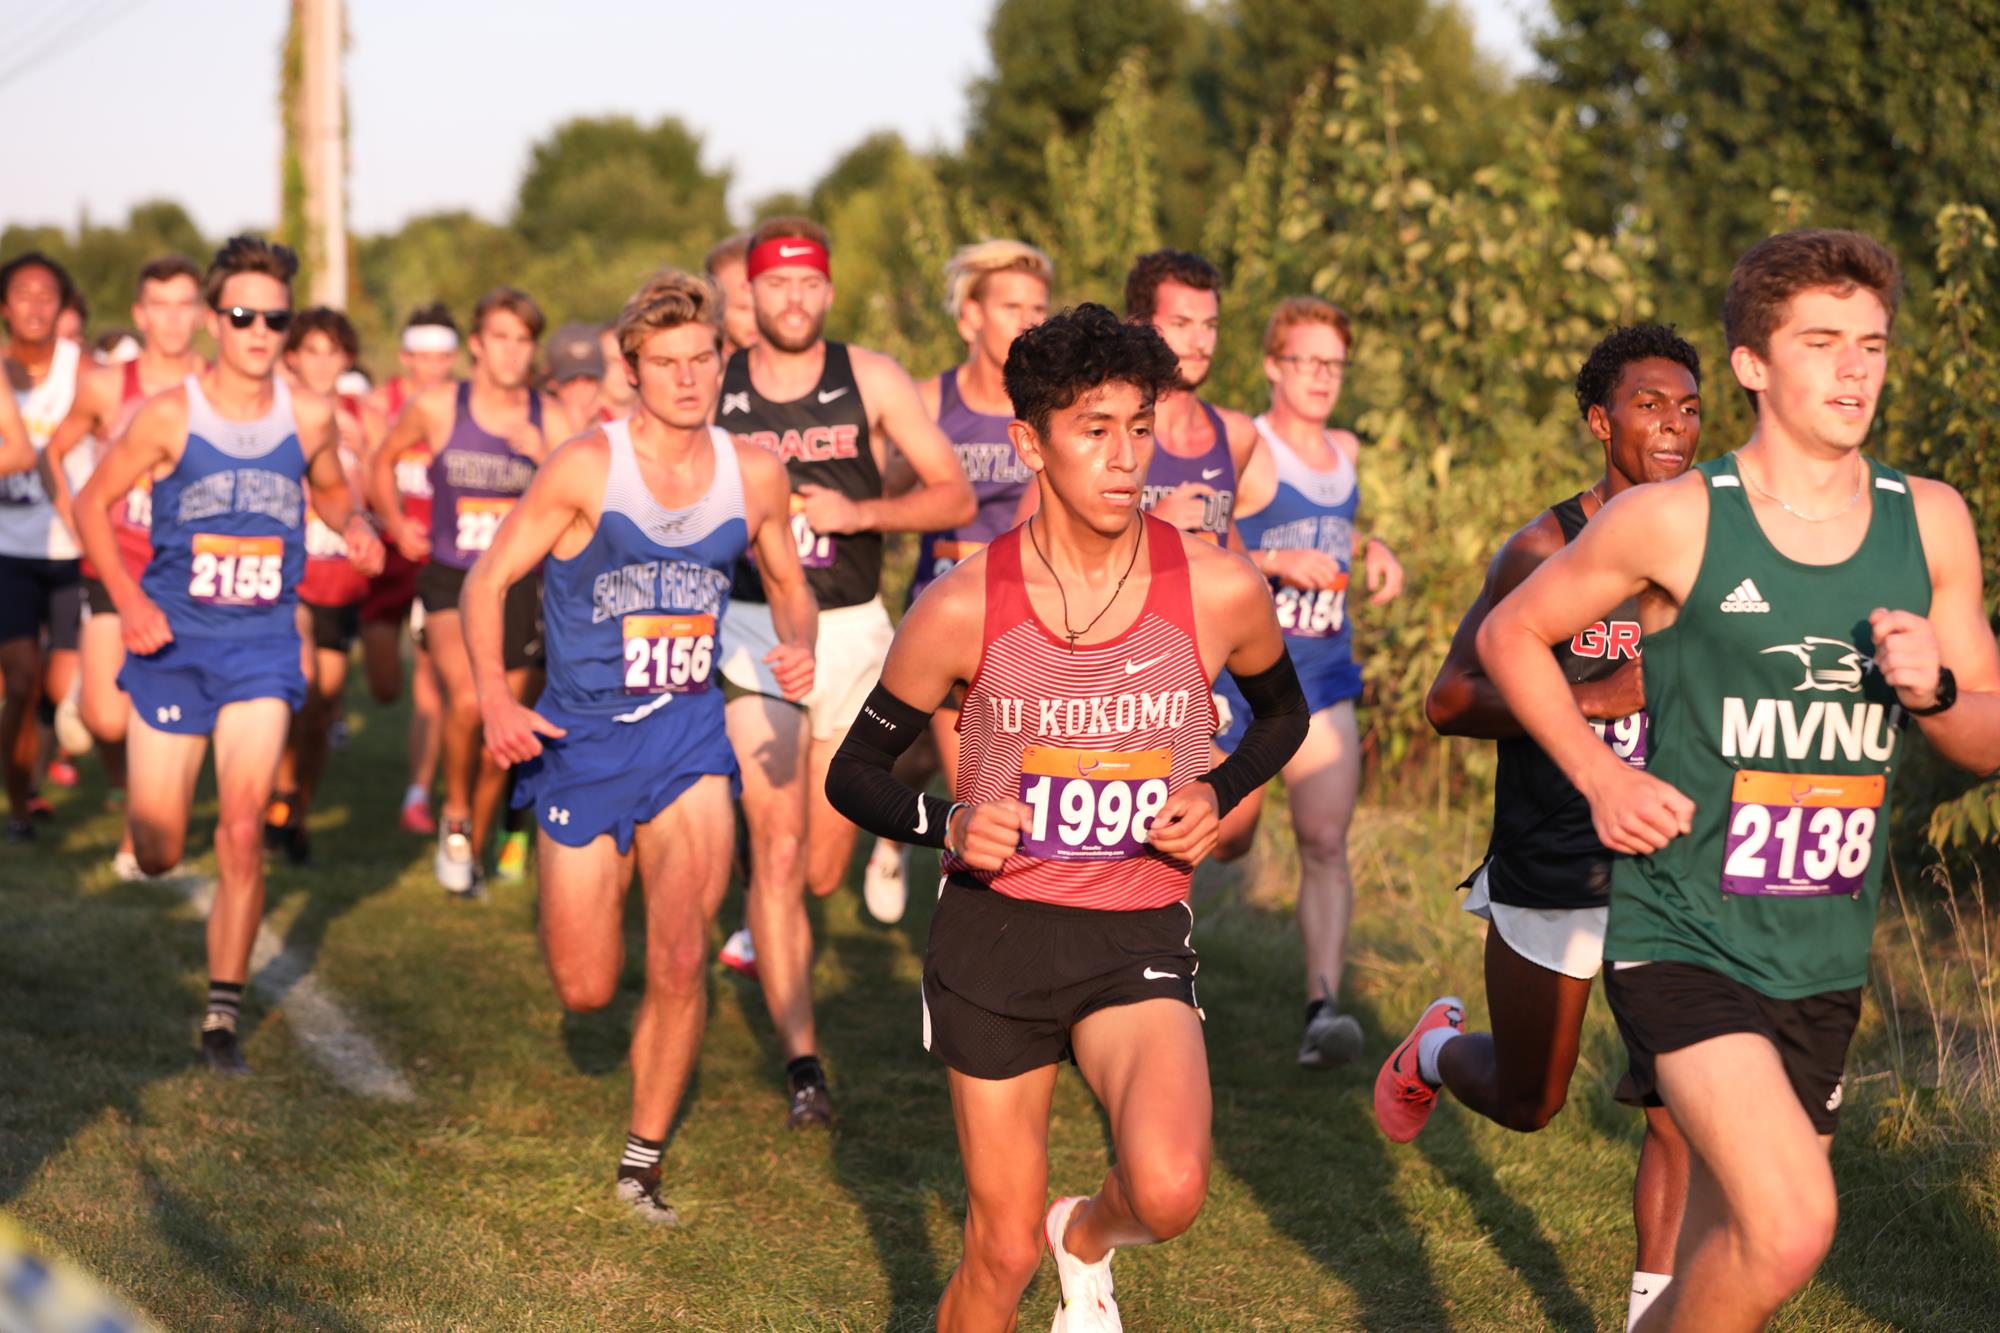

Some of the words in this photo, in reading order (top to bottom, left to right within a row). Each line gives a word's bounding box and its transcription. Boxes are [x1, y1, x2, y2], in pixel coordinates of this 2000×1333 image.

[736, 424, 858, 464] RACE
[189, 552, 282, 600] 2155
[624, 634, 714, 688] 2156
[1037, 690, 1189, 736] KOKOMO
[1722, 697, 1900, 761] MVNU
[1025, 776, 1169, 846] 1998
[1724, 804, 1876, 880] 2138
